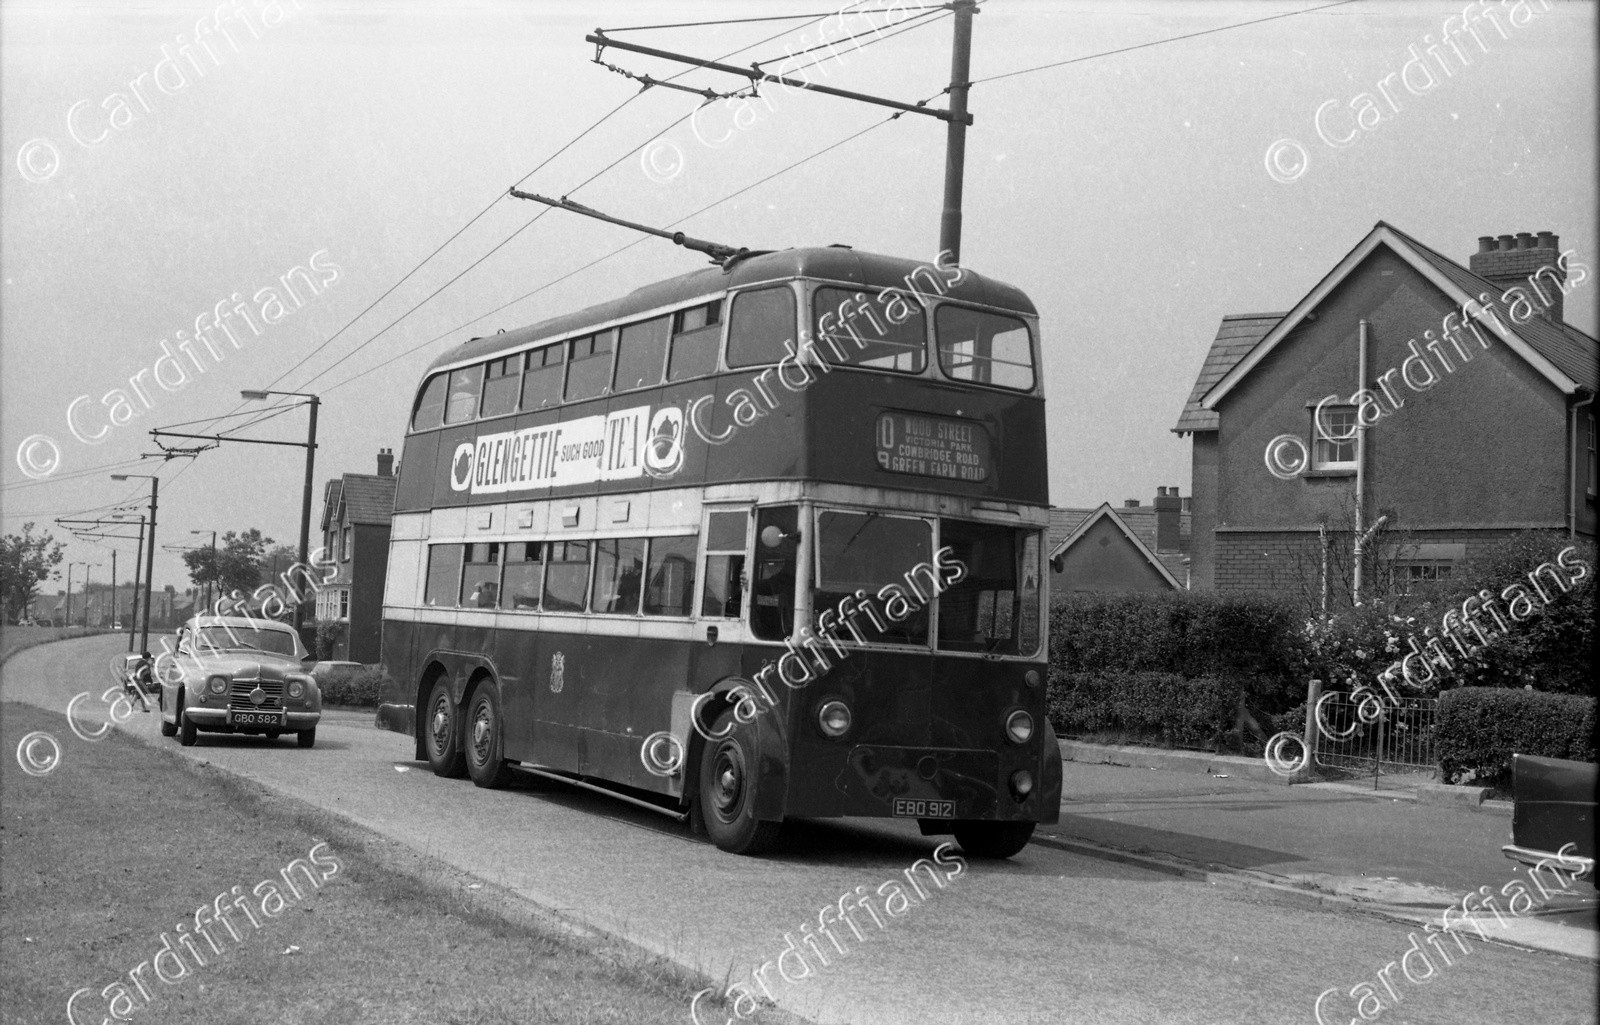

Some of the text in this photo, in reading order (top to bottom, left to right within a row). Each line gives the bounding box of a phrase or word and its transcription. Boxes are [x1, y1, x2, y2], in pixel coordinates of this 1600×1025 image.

[905, 418, 972, 442] WOOD STREET
[476, 414, 639, 486] GLENGETTIE SUCH GOOD TEA
[905, 435, 972, 452] VICTORIA PARK
[899, 444, 979, 465] COWBRIDGE ROAD
[892, 456, 985, 480] GREEN FARM ROAD
[234, 713, 278, 724] GBO 582
[896, 801, 952, 817] EBO 912
